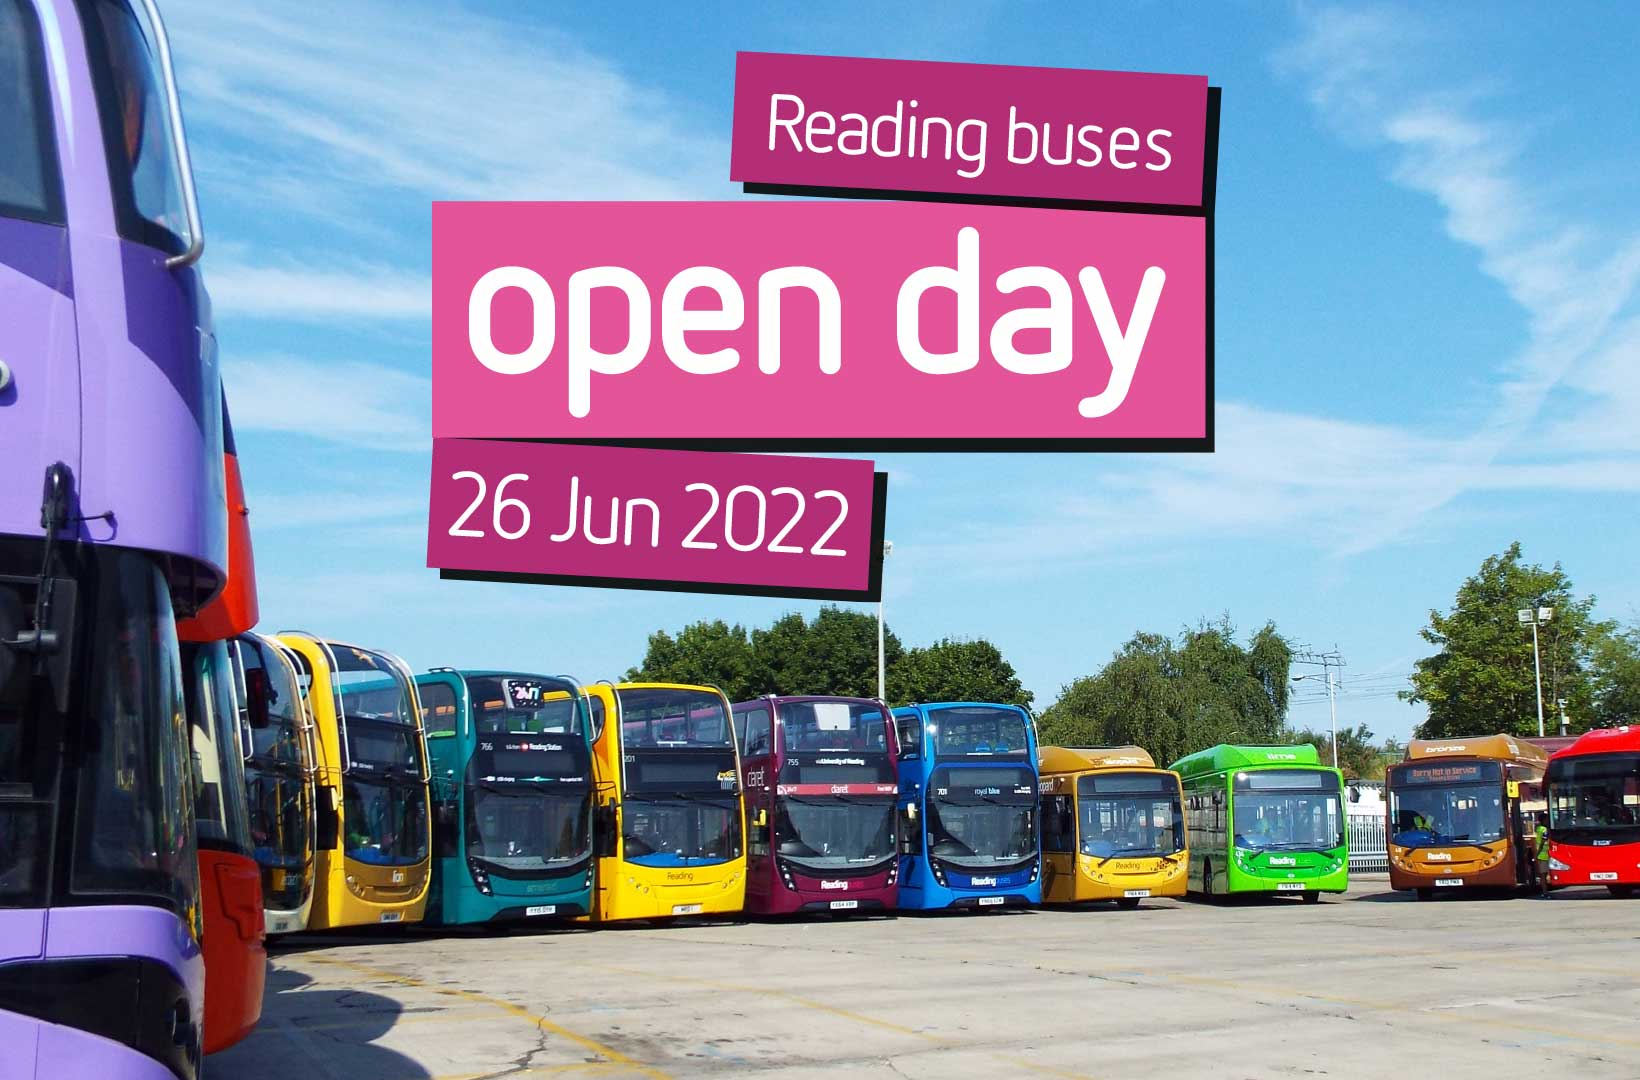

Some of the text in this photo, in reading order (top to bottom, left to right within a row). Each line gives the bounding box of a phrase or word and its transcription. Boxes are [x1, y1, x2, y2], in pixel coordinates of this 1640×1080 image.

[787, 758, 799, 766] 755
[974, 788, 987, 797] royal
[1269, 856, 1297, 866] Reading
[1115, 862, 1140, 871] Reading
[667, 871, 693, 882] Reading
[971, 876, 997, 887] Reading
[820, 880, 848, 891] Reading
